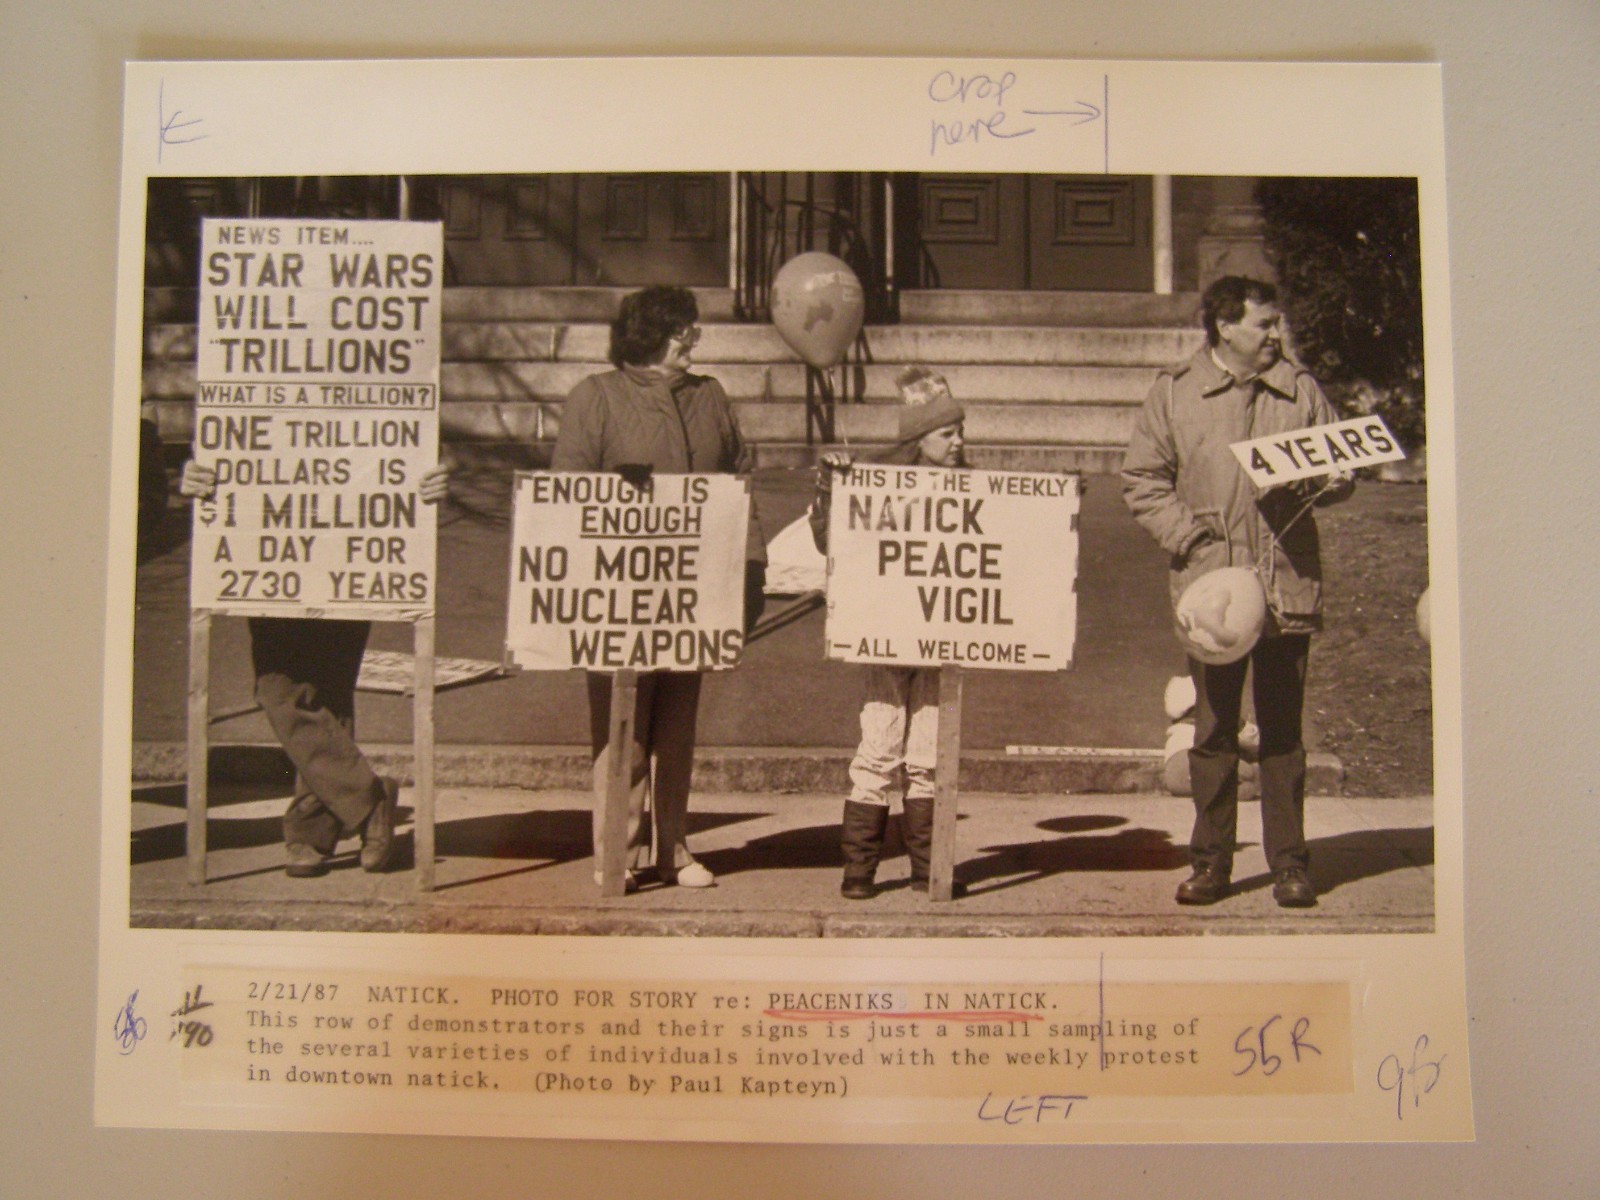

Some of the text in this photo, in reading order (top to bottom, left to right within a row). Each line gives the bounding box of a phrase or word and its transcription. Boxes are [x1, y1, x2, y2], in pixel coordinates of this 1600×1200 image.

[218, 227, 281, 245] NEWS
[208, 252, 434, 289] STAR WARS
[214, 295, 429, 331] WILL COST
[209, 338, 425, 374] "TRILLIONS"
[201, 385, 430, 406] WHAT IS A TRILLION?
[201, 415, 419, 451] ONE TRILLION
[1251, 424, 1394, 476] 4 YEARS
[215, 458, 406, 486] DOLLARS IS
[840, 469, 1069, 497] THIS IS THE WEEKLY
[532, 476, 710, 504] ENOUGH IS
[200, 492, 416, 529] $1 MILLION
[580, 505, 702, 534] ENOUGH
[848, 494, 984, 535] NATICK
[214, 535, 406, 564] A DAY FOR
[519, 545, 700, 582] NO MORE
[878, 540, 1003, 580] PEACE
[220, 570, 428, 600] 2730 YEARS
[530, 588, 699, 625] NUCLEAR
[917, 585, 1014, 626] VIGIL
[569, 629, 743, 666] WEAPONS
[248, 982, 1058, 1010] 2/21/87 NATICK. PHOTO FOR STORY re: PEACENIKS IN NATICK.
[247, 1011, 1200, 1041] This row of demonstrators and their signs is just a small sampling of
[247, 1039, 1200, 1070] the several varieties of individuals involved with the weekly protest
[247, 1065, 849, 1097] in downtown natick. (Photo by Paul Kapteyn)
[978, 1092, 1088, 1124] LEFT
